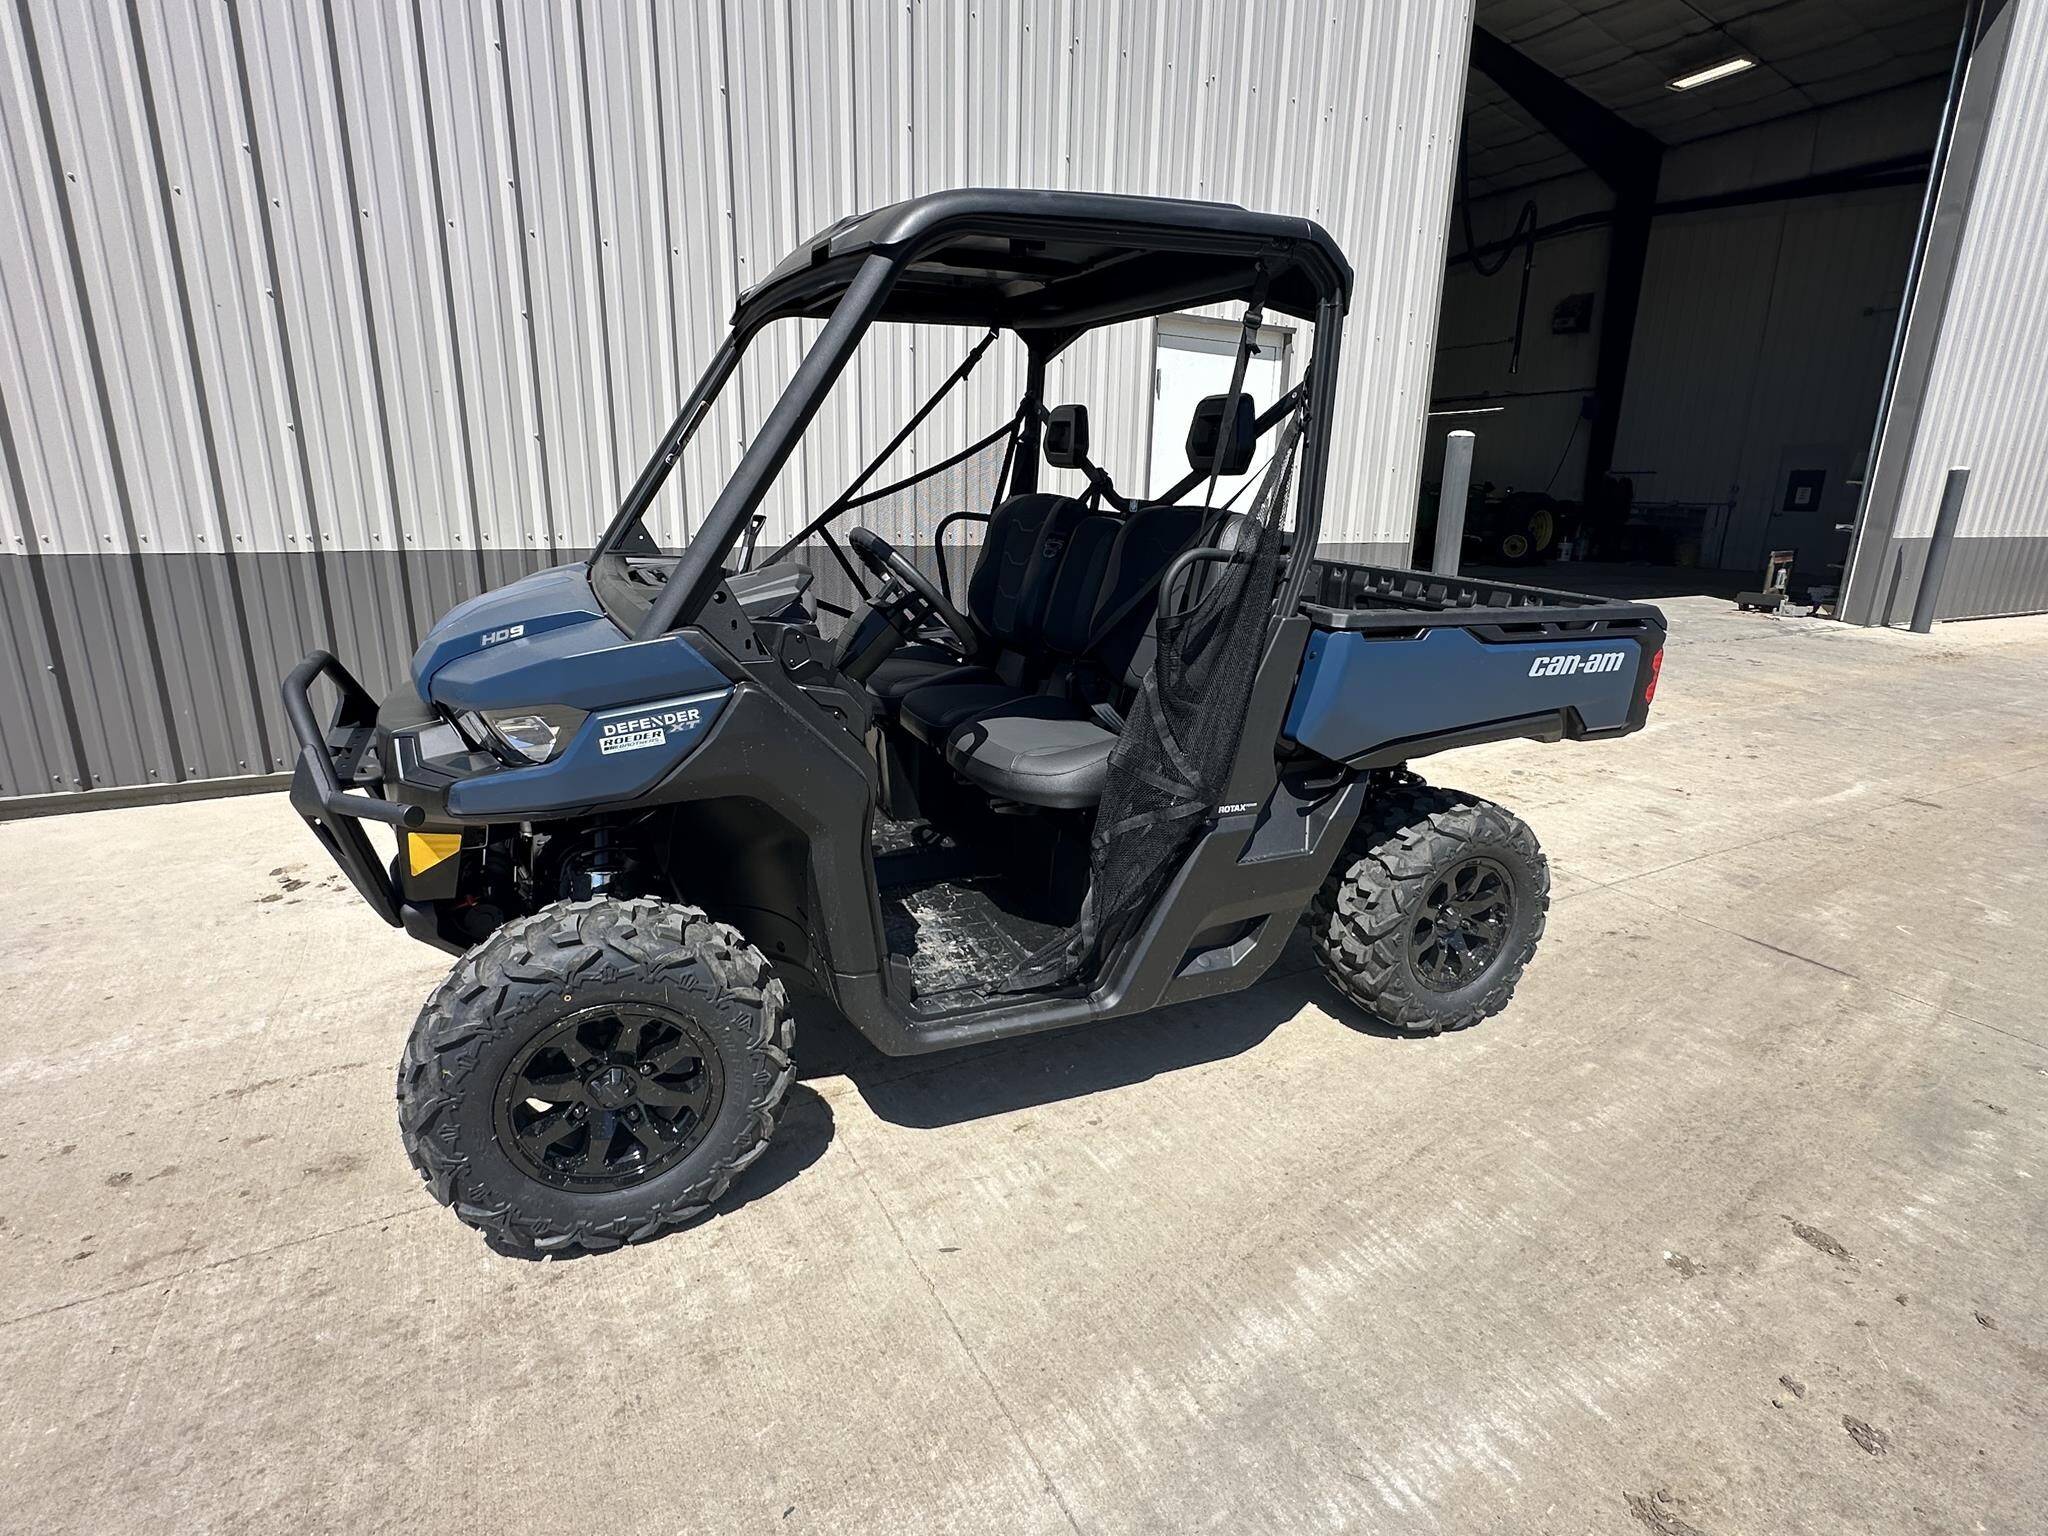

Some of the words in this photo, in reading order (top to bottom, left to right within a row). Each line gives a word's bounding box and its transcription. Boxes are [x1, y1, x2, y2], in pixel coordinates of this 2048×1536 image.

[481, 624, 525, 646] HD9
[1528, 652, 1625, 677] can-am
[603, 709, 700, 736] DEFENDER
[667, 720, 700, 734] XT
[603, 731, 662, 746] ROEDER
[1218, 803, 1246, 814] ROTAX
